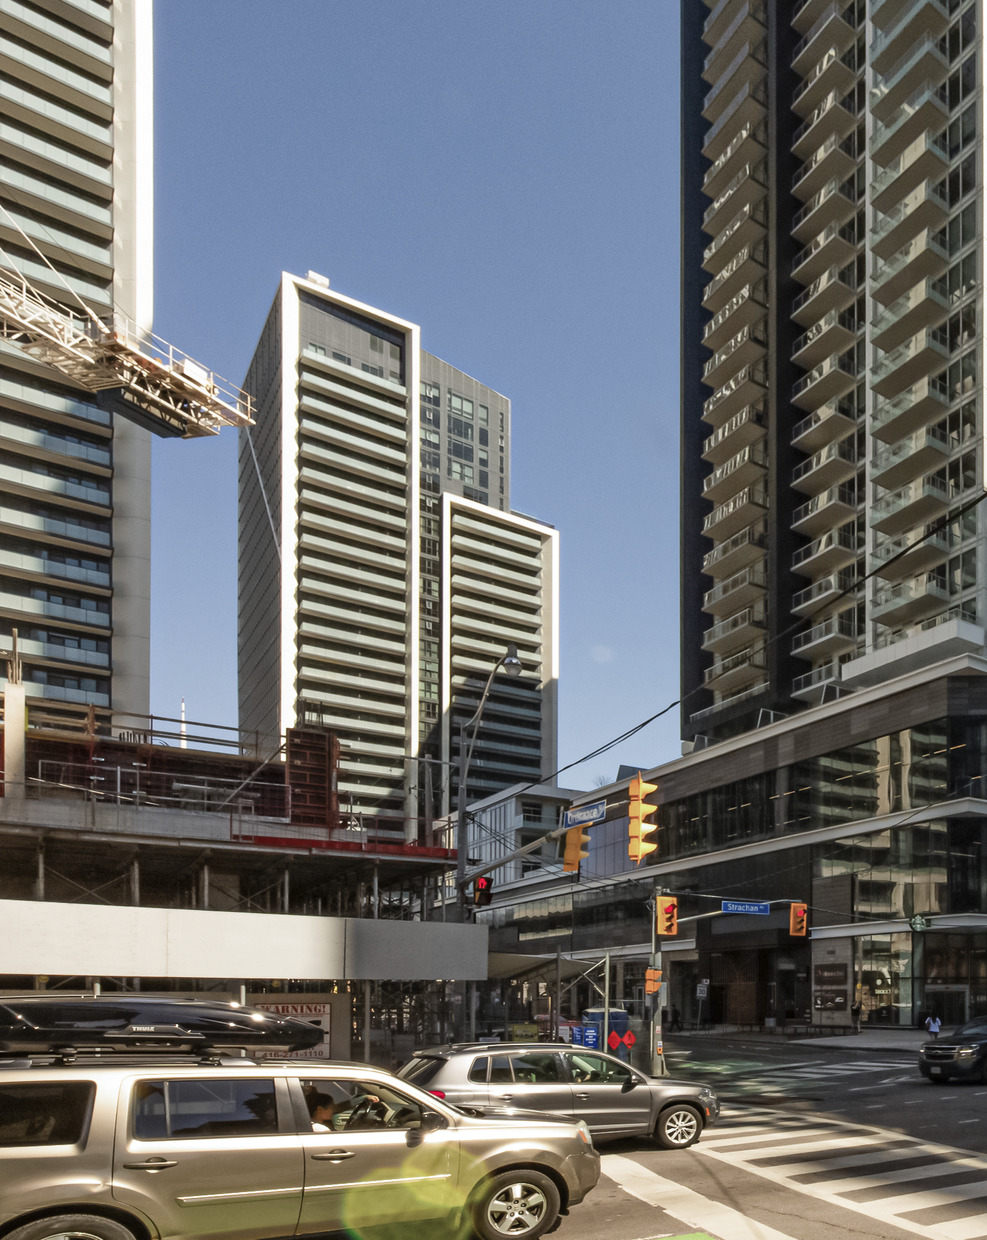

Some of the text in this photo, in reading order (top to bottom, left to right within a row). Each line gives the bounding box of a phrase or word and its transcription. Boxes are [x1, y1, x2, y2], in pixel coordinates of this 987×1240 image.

[727, 903, 759, 911] Strachan
[260, 1005, 327, 1014] WARNING!
[263, 1050, 324, 1058] 416-271-1110
